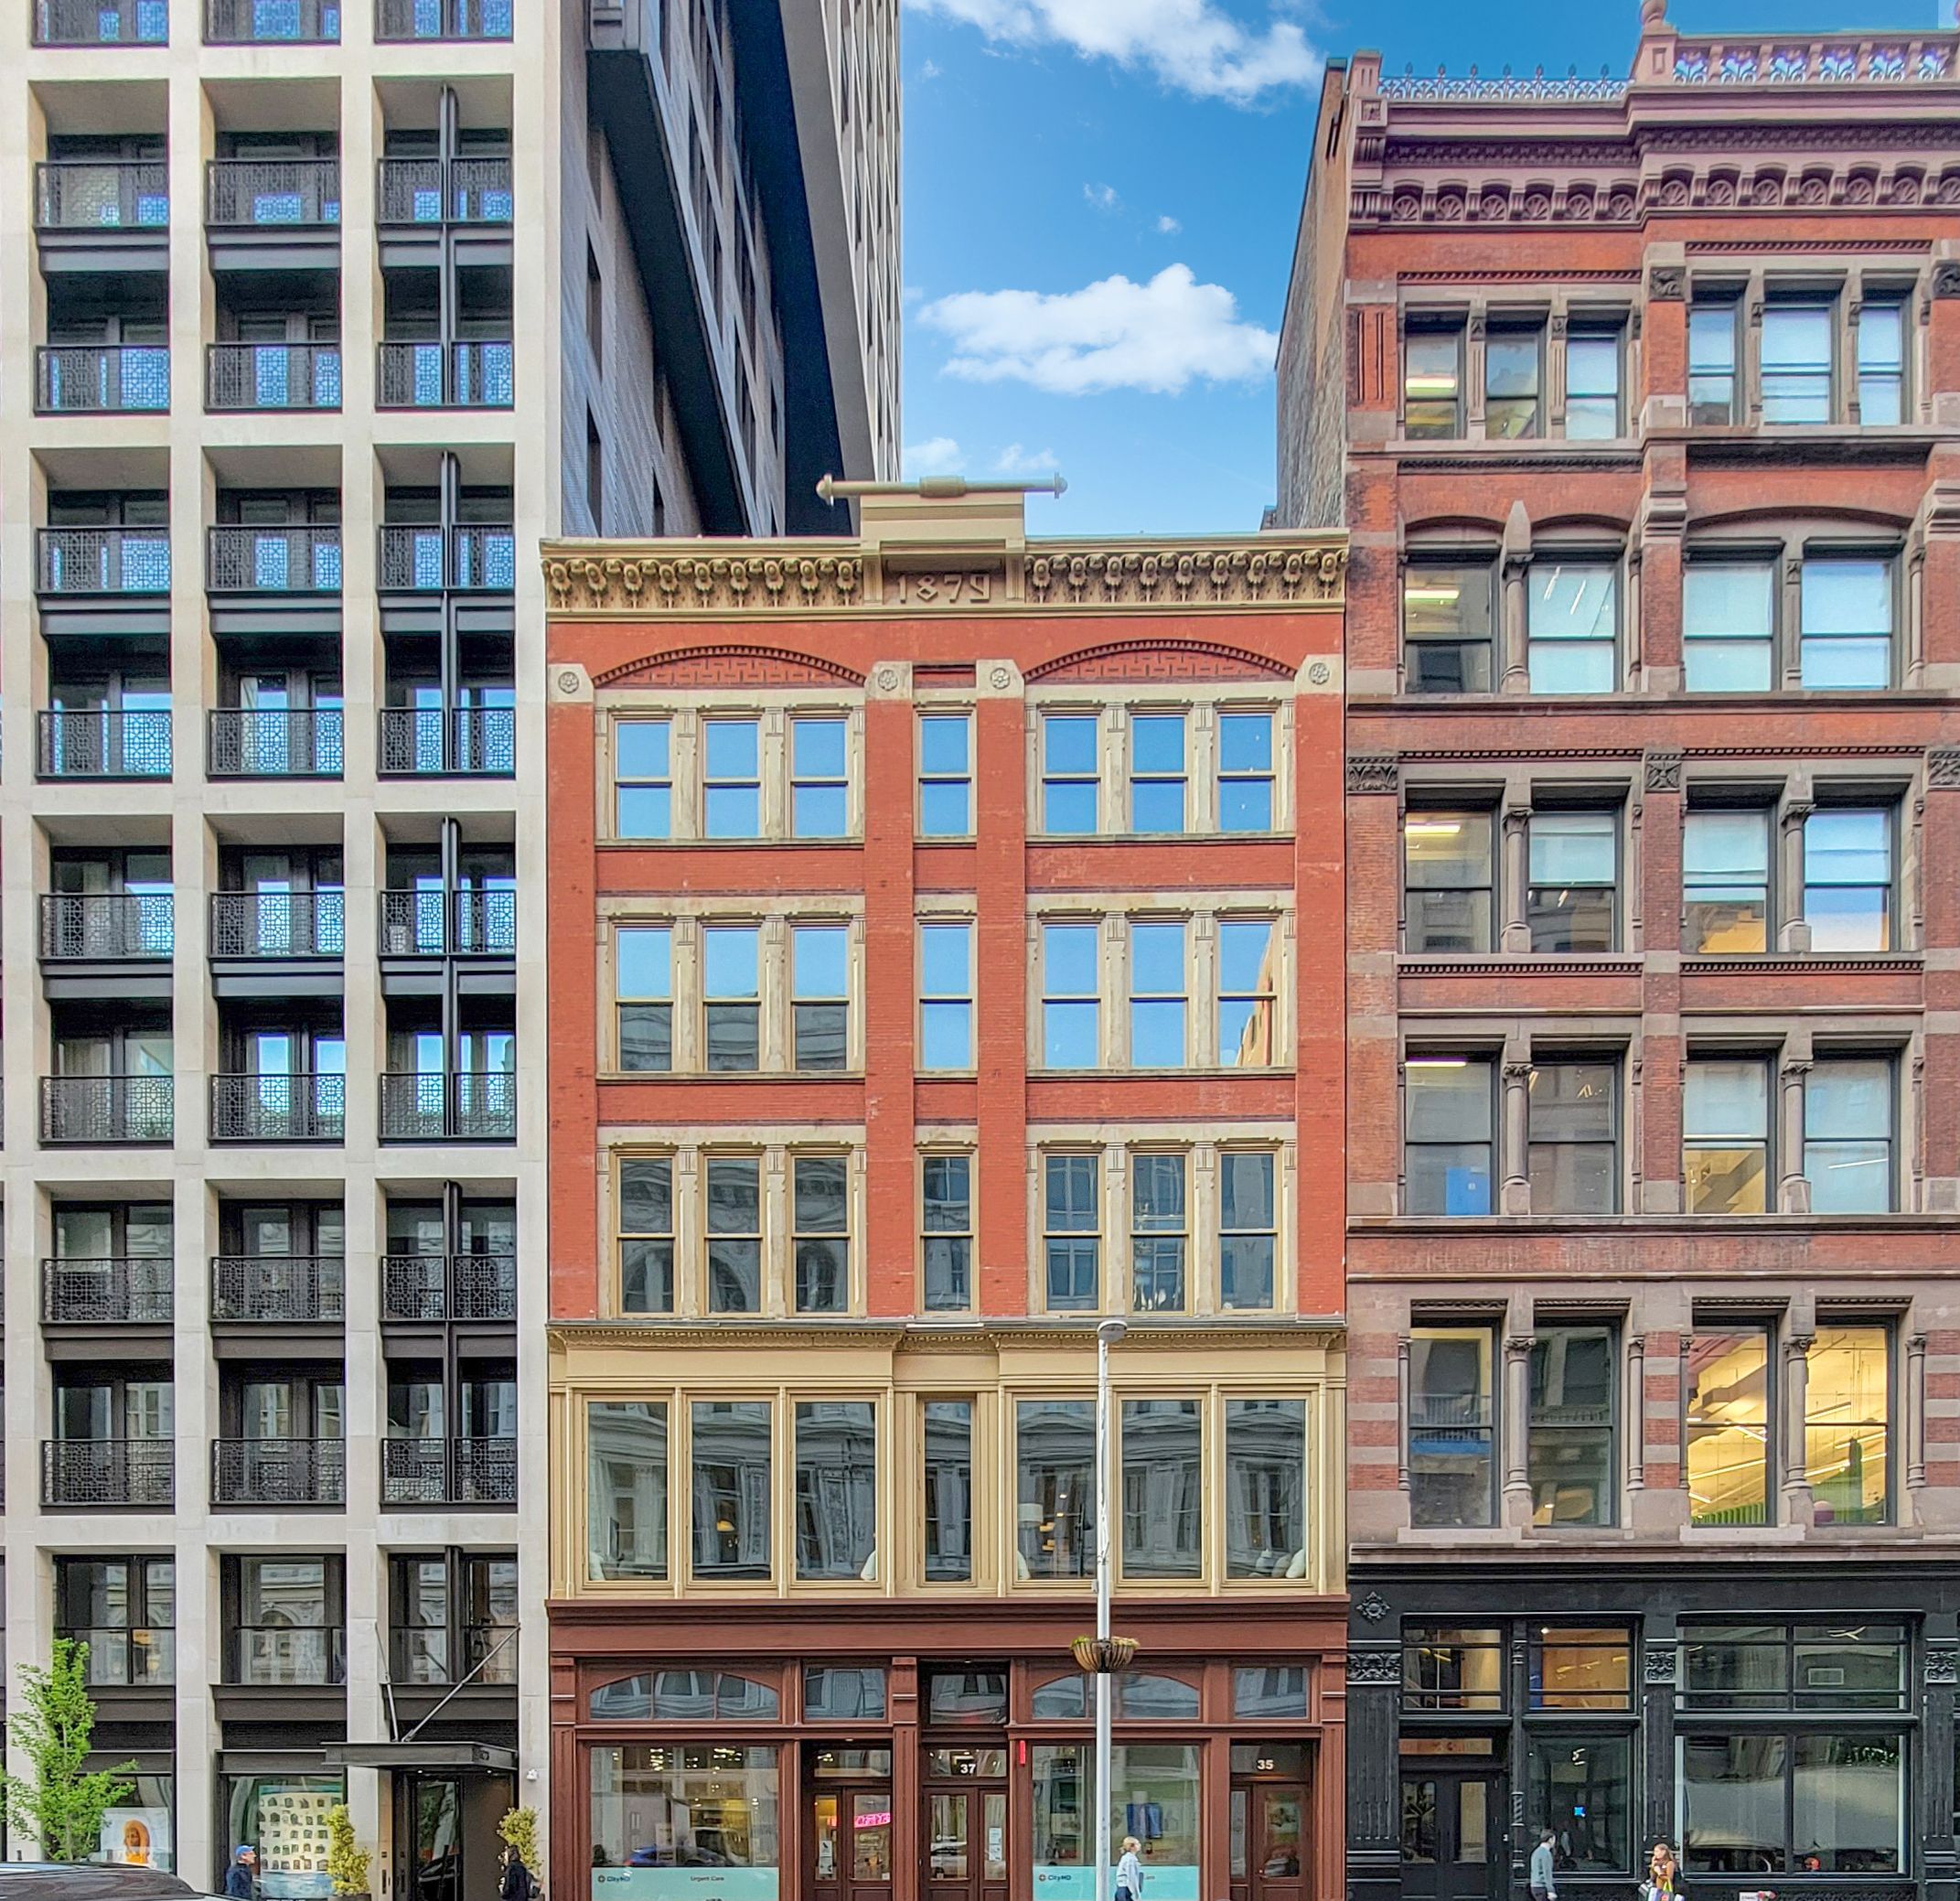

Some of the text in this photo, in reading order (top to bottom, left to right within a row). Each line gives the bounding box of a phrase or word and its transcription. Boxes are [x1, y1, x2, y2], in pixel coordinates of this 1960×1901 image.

[897, 573, 990, 603] 1879
[959, 1763, 976, 1774] 37
[1257, 1758, 1274, 1770] 35
